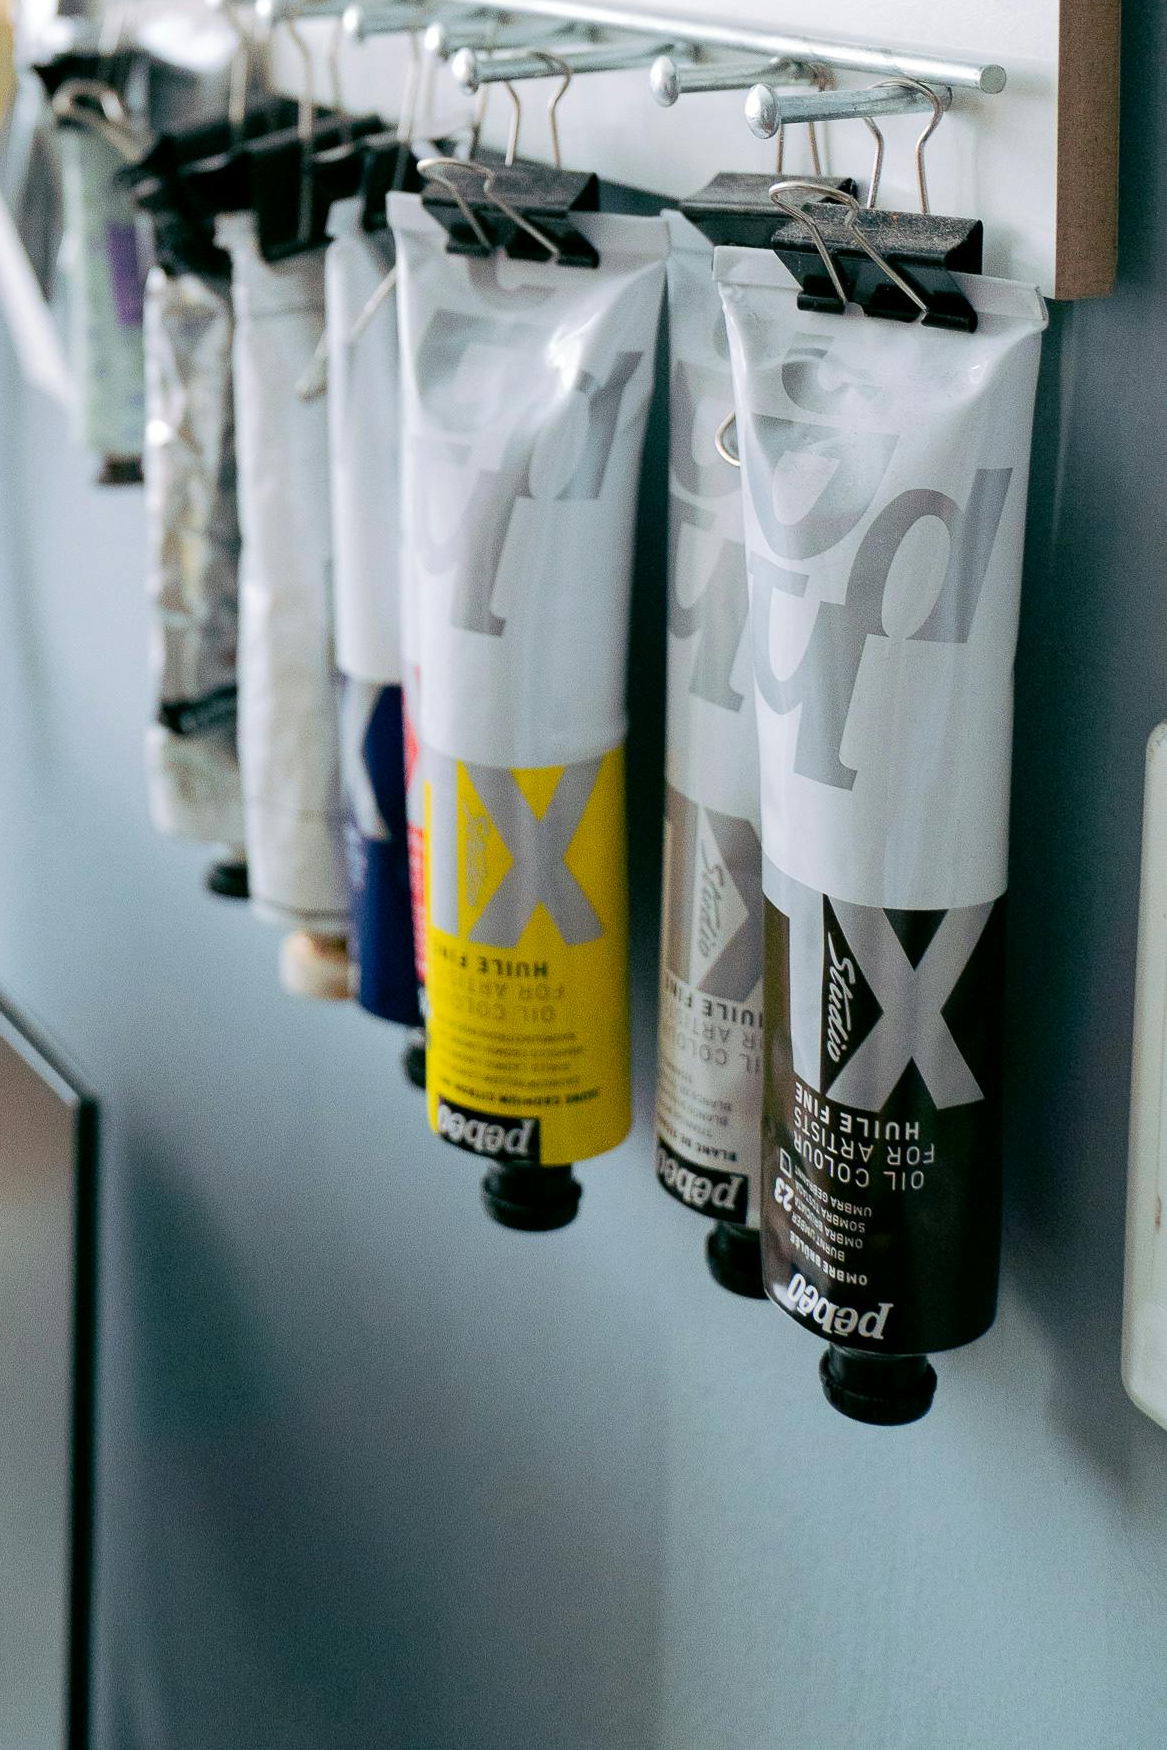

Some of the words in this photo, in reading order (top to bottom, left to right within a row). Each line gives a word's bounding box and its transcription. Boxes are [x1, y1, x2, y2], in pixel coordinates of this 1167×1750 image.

[827, 931, 856, 1063] Studio
[795, 1082, 830, 1125] FINE
[793, 1106, 874, 1164] ARTISTS
[839, 1112, 919, 1141] HUILE
[793, 1130, 870, 1188] COLOUR
[886, 1142, 935, 1166] FOR
[773, 1176, 795, 1212] 23
[882, 1170, 925, 1191] OIL
[820, 1206, 866, 1233] SOMBRA
[830, 1195, 873, 1218] UMBRA
[791, 1211, 816, 1238] UMBER
[824, 1225, 864, 1249] OMBRA
[816, 1234, 846, 1262] BURNT
[822, 1260, 868, 1287] OMBRE
